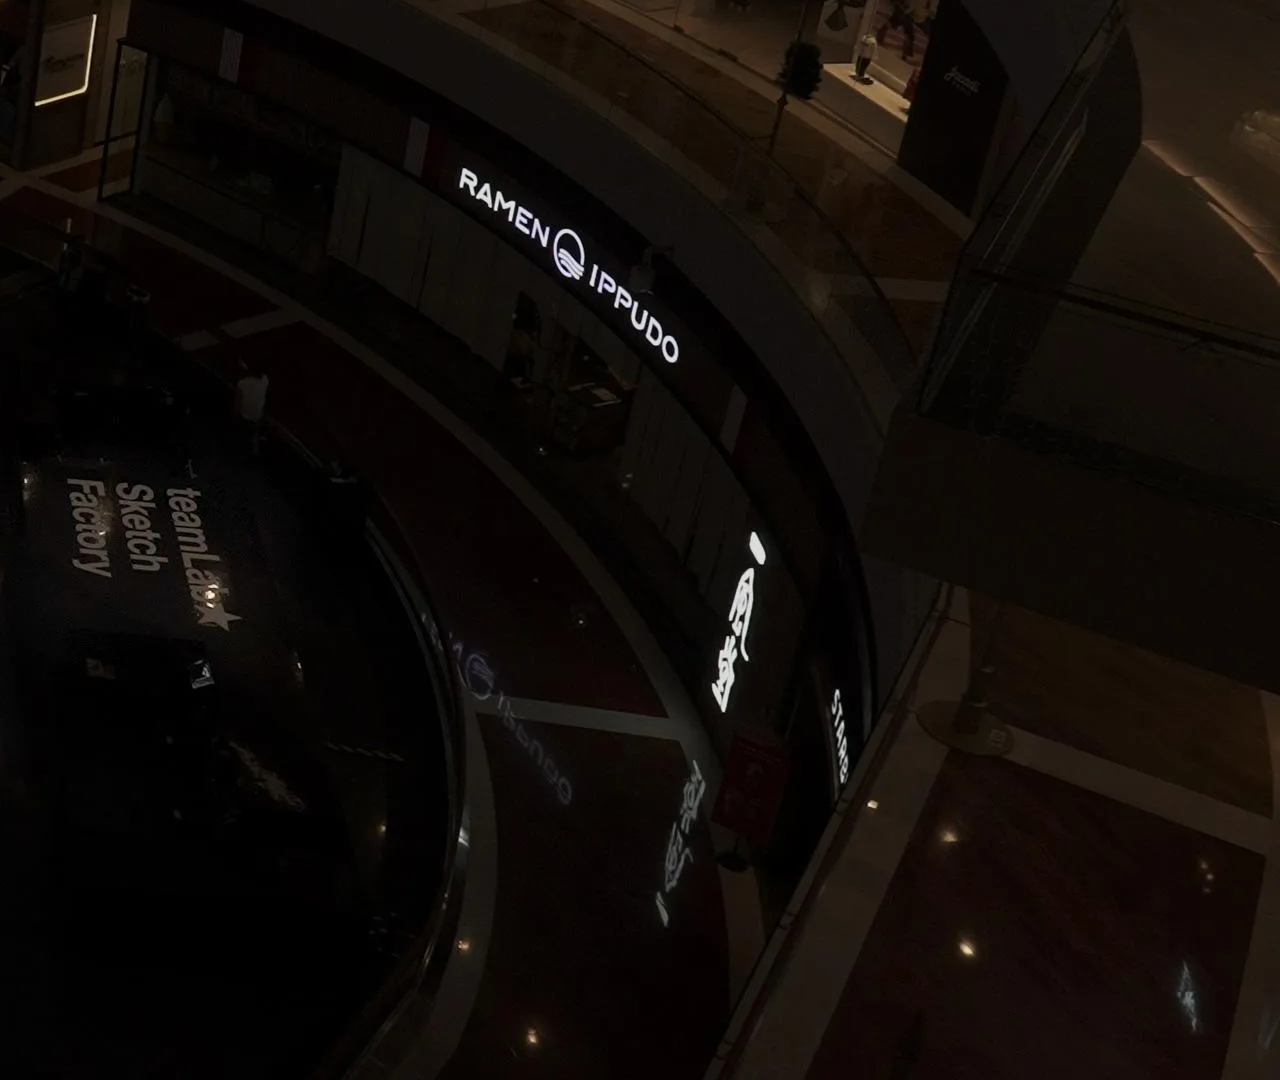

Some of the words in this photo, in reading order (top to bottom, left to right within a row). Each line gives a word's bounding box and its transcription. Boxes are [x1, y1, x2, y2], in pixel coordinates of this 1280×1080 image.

[457, 166, 551, 249] RAMEN
[588, 262, 681, 366] IPPUDO
[66, 477, 113, 579] Factory
[114, 481, 169, 572] Sketch
[830, 688, 849, 785] STARB
